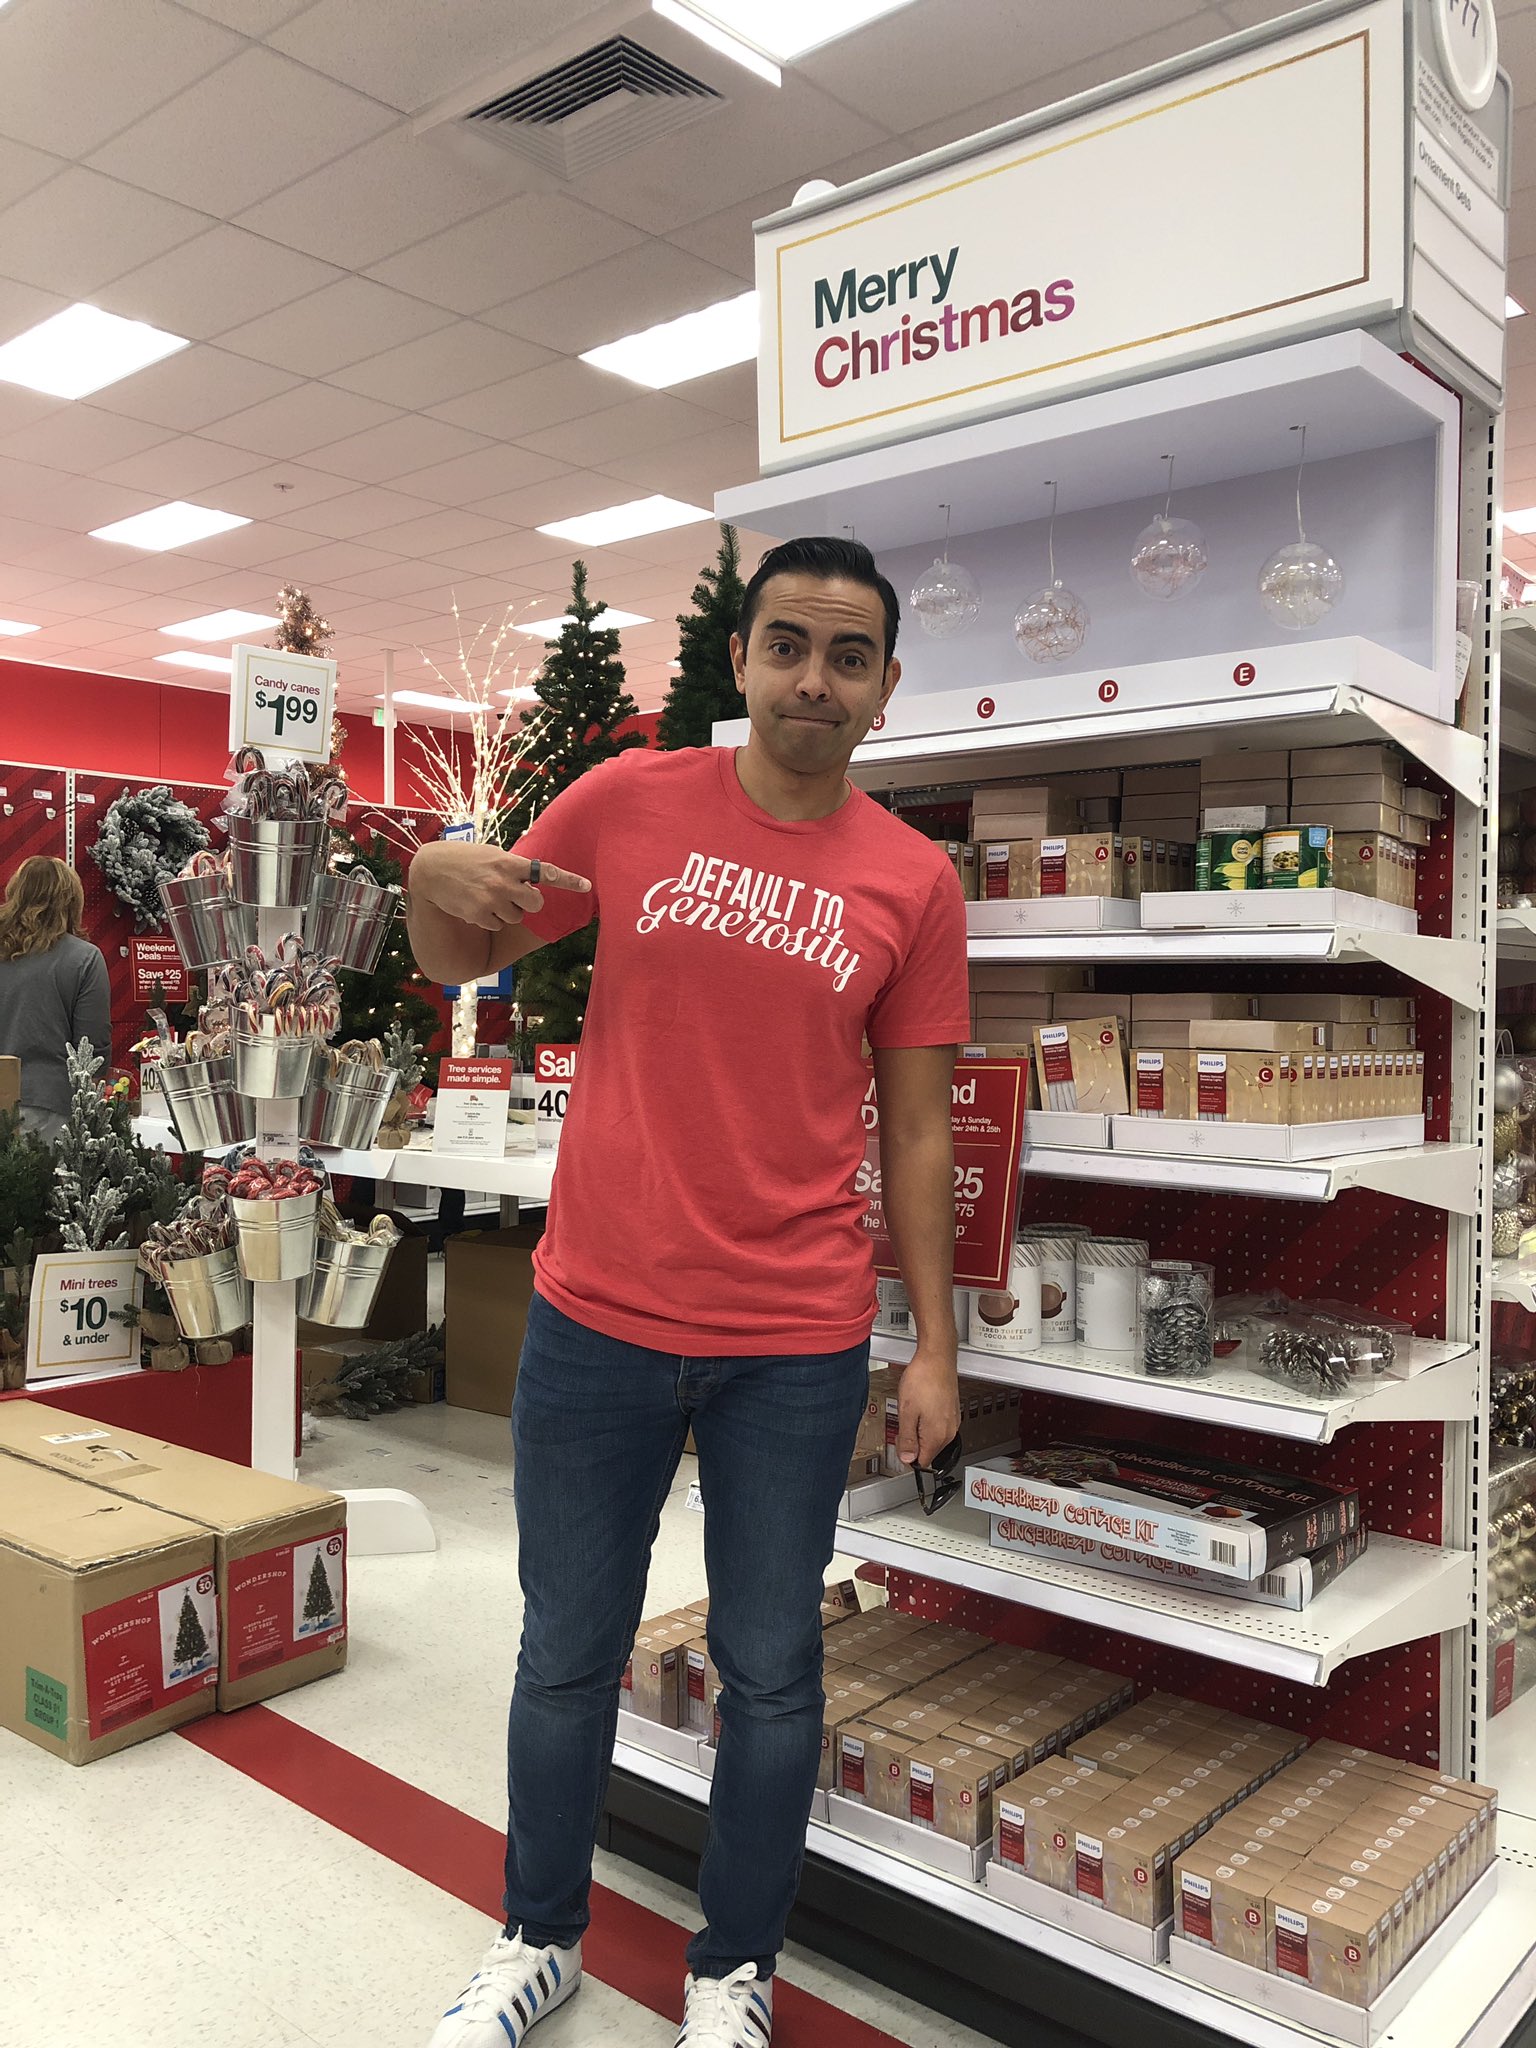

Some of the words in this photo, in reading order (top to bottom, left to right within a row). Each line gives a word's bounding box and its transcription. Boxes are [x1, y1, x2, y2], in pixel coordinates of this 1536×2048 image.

[1418, 141, 1454, 194] Ornament
[1453, 182, 1472, 212] Sets
[814, 247, 960, 328] Merry
[814, 278, 1076, 388] Christmas
[1239, 668, 1249, 681] E
[254, 675, 288, 691] Candy
[290, 683, 320, 696] canes
[1104, 684, 1114, 697] D
[981, 701, 990, 714] C
[1098, 849, 1106, 858] A
[1362, 848, 1371, 857] A
[681, 851, 806, 922] DEFAULT
[810, 887, 844, 930] TO
[636, 877, 861, 993] Generosity
[136, 943, 176, 952] Weekend
[137, 951, 161, 960] Deals
[138, 968, 164, 979] Save
[165, 969, 181, 979] $25
[1042, 1032, 1065, 1040] PHILIPS
[1102, 1033, 1110, 1042] C
[448, 1064, 466, 1073] Tree
[467, 1065, 502, 1074] services
[538, 1050, 576, 1078] Sal
[447, 1074, 470, 1083] made
[471, 1075, 501, 1084] simple.
[1261, 1070, 1269, 1079] C
[967, 1116, 992, 1125] Sunday
[854, 1160, 882, 1193] Sa
[954, 1166, 984, 1200] 25
[60, 1279, 86, 1291] Mini
[88, 1278, 118, 1290] trees
[60, 1296, 108, 1331] $10
[62, 1335, 72, 1346] &
[75, 1332, 110, 1345] under
[1115, 1451, 1210, 1477] GINGERBREAD
[1212, 1474, 1285, 1495] COTTAGE
[1286, 1491, 1316, 1502] KIT
[970, 1478, 1060, 1517] GINGERBREAD
[1063, 1503, 1131, 1539] COTTAGE
[1135, 1518, 1160, 1542] KIT
[997, 1518, 1096, 1554] GINGERBREAD
[327, 1543, 341, 1554] 30
[199, 1581, 212, 1593] 30
[234, 1571, 287, 1592] WONDERSHOP
[91, 1616, 152, 1646] WONDERSHOP
[844, 1742, 862, 1752] PHILIPS
[912, 1767, 932, 1779] PHILIPS
[1001, 1807, 1023, 1820] PHILIPS
[1056, 1836, 1064, 1846] B
[1077, 1839, 1100, 1853] PHILIPS
[1137, 1870, 1145, 1880] B
[1183, 1878, 1209, 1893] PHILIPS
[1249, 1912, 1257, 1922] B
[1277, 1913, 1305, 1929] PHILIPS
[1348, 1949, 1357, 1960] B
